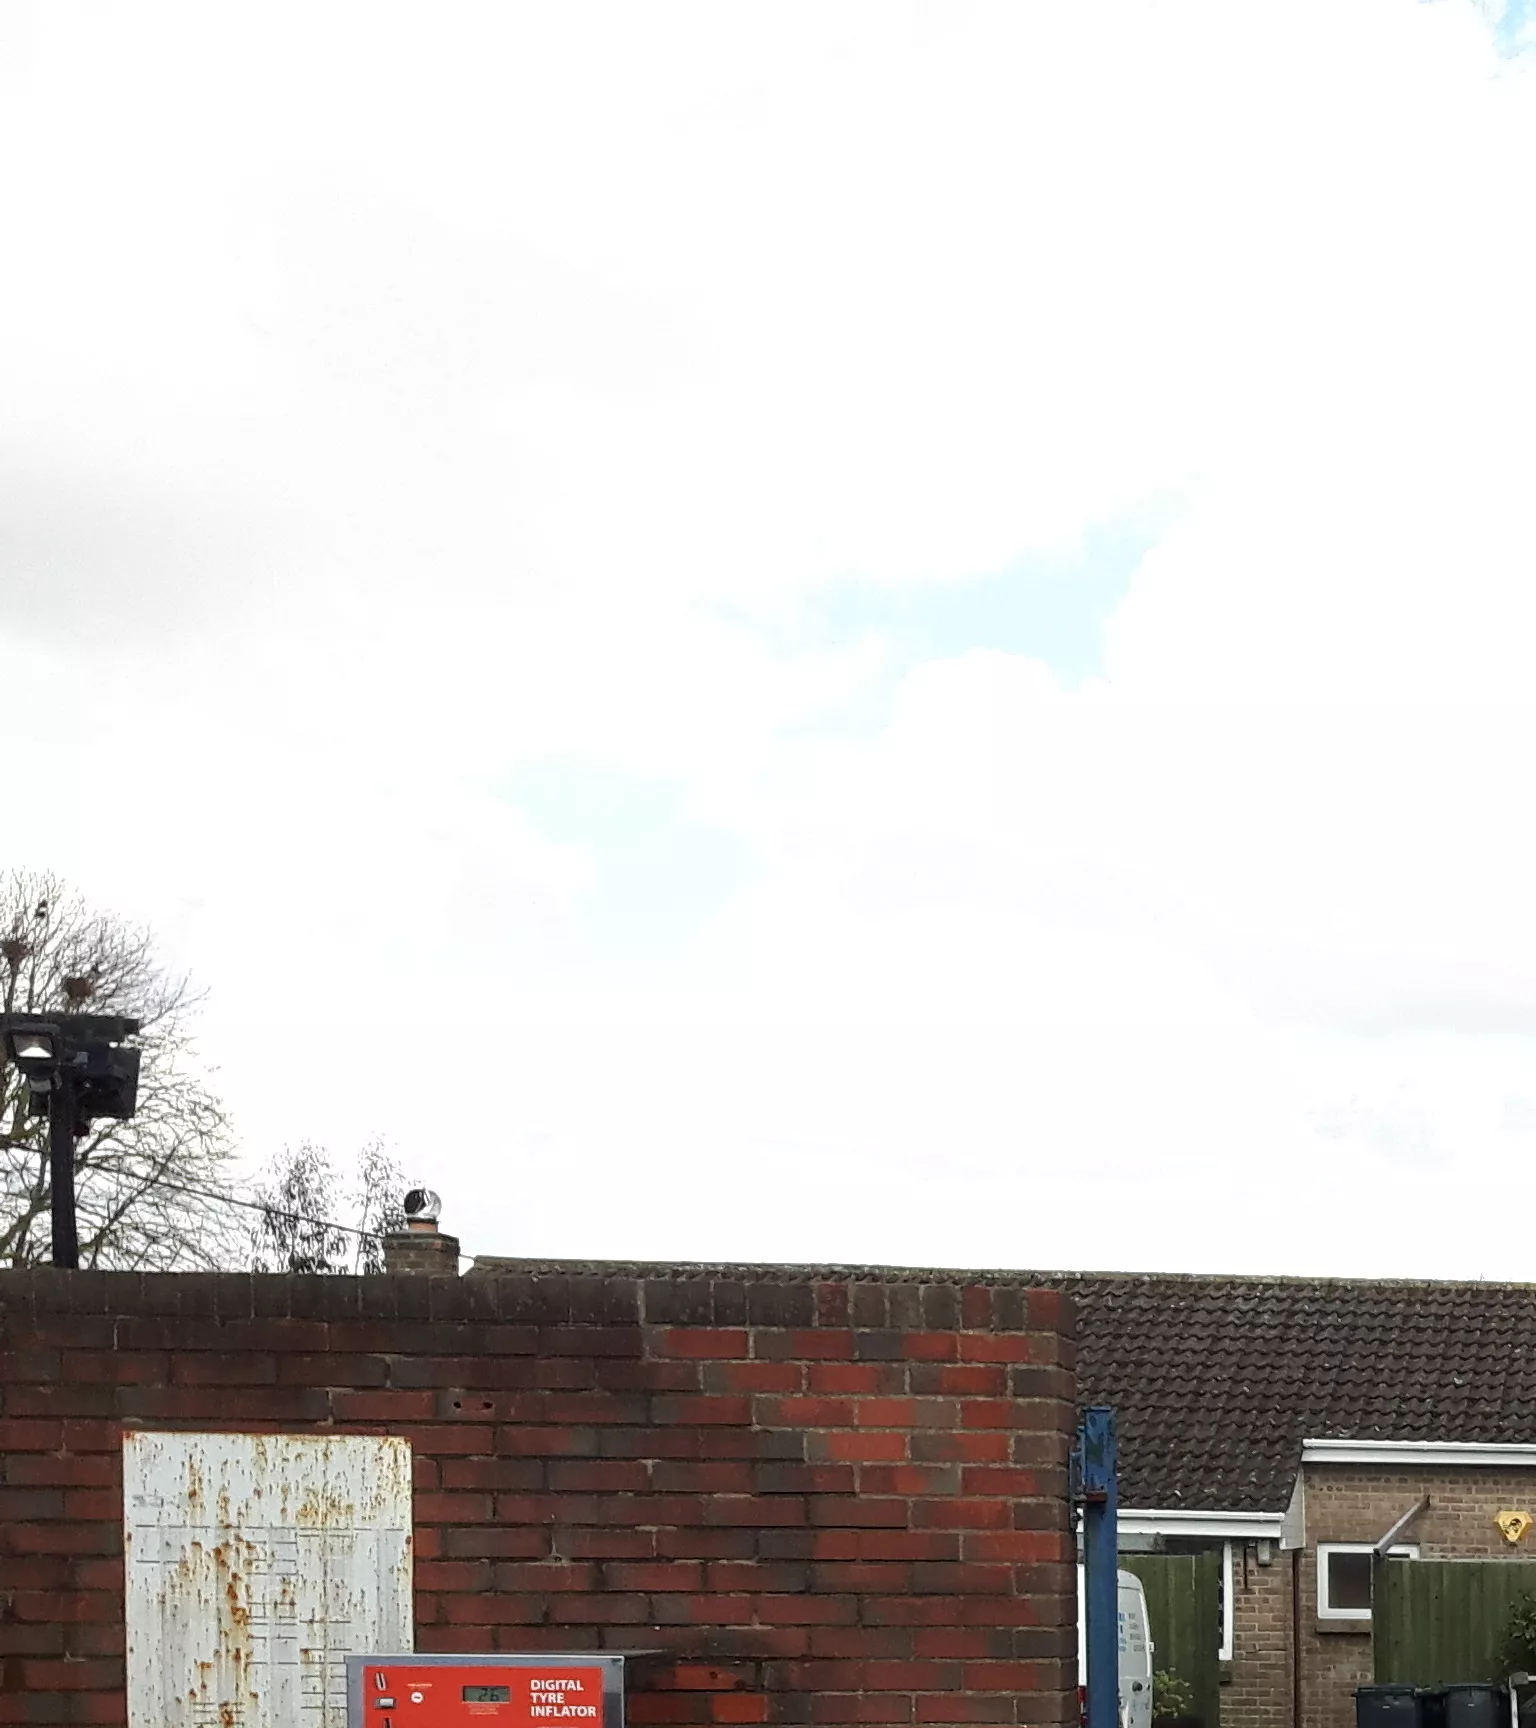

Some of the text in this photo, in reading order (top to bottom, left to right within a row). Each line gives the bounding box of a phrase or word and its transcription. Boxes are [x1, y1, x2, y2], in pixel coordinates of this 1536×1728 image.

[530, 1680, 584, 1691] DIGITAL
[530, 1692, 565, 1703] TYRE
[530, 1705, 596, 1717] INFLATOR
